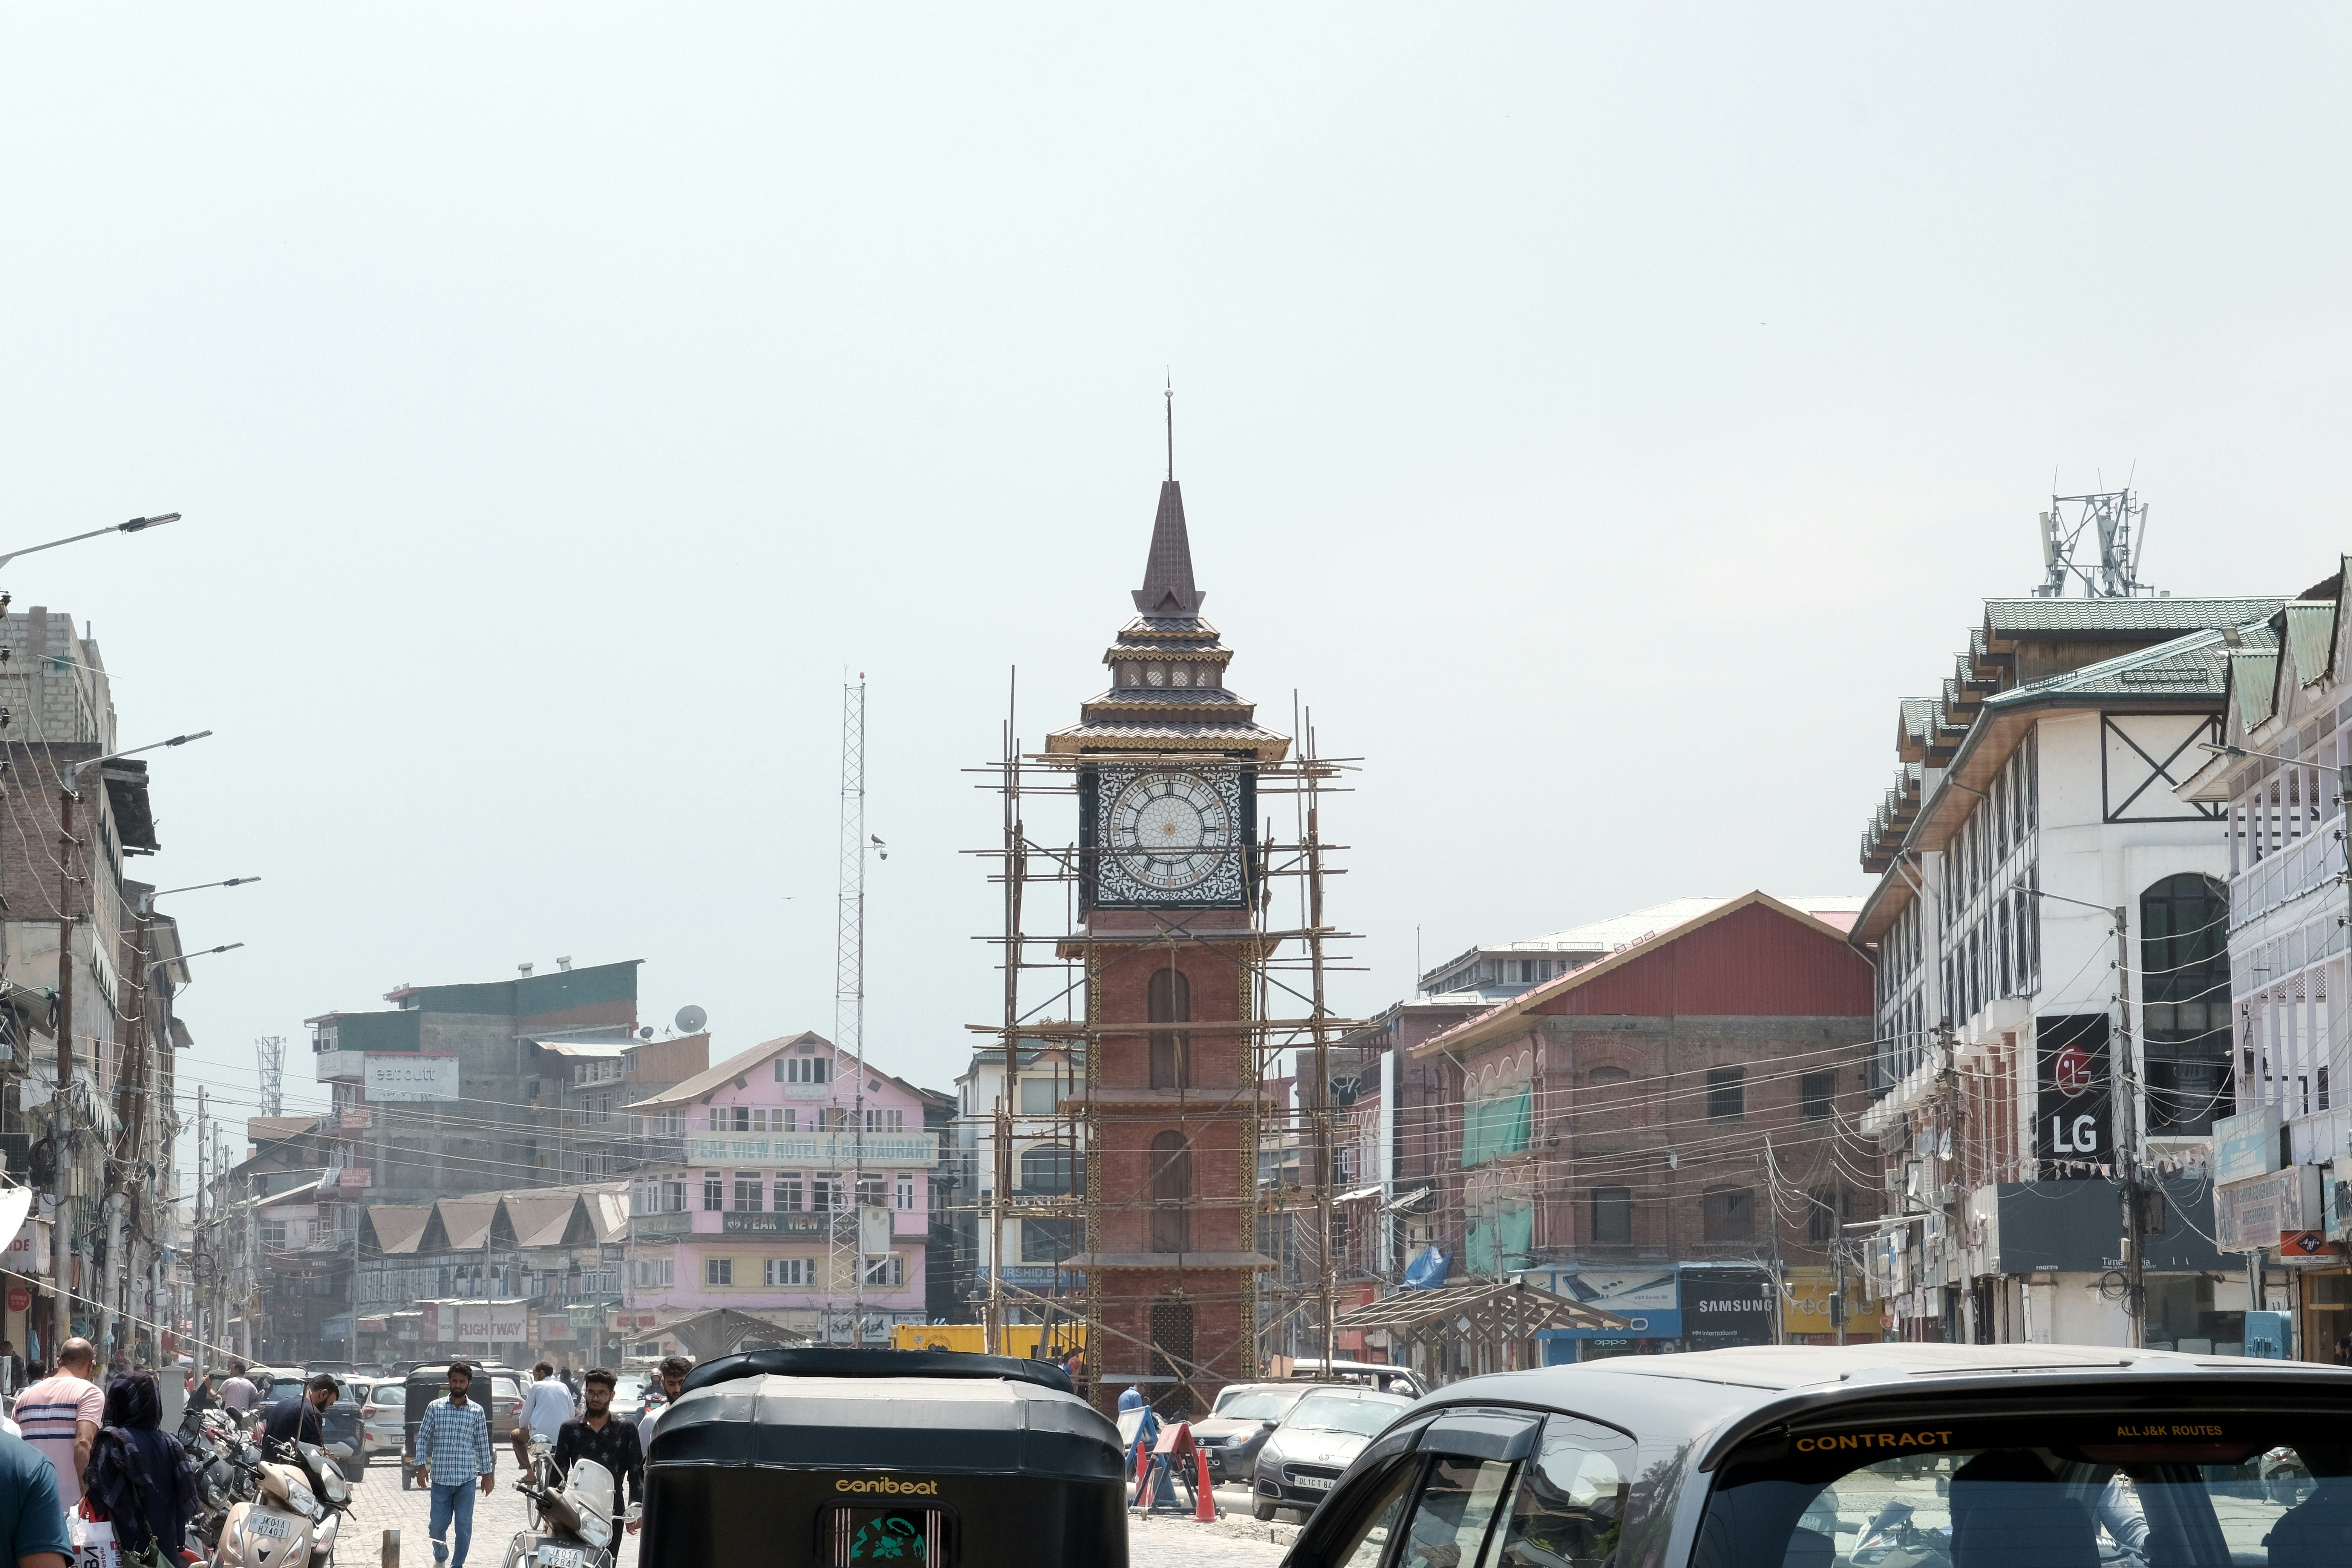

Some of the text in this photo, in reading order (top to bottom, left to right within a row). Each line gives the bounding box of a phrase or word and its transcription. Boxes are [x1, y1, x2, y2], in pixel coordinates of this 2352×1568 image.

[377, 1067, 401, 1080] eat
[404, 1066, 435, 1081] outt
[2053, 1115, 2096, 1153] LG
[691, 1139, 727, 1159] PEAK
[733, 1138, 769, 1159] VIEW
[775, 1138, 820, 1159] HOTEL
[744, 1217, 777, 1230] PEAK
[787, 1217, 819, 1230] VIEW
[6, 1239, 30, 1251] IDE
[2300, 1238, 2320, 1250] Agfa
[2102, 1257, 2123, 1266] Time
[981, 1268, 1043, 1277] KURSHID
[1700, 1300, 1772, 1312] SAMSUNG
[2117, 1425, 2223, 1436] ALL J&K ROUTES
[1797, 1431, 1952, 1452] CONTRACT
[835, 1476, 938, 1495] canibeat
[258, 1525, 283, 1537] H7403
